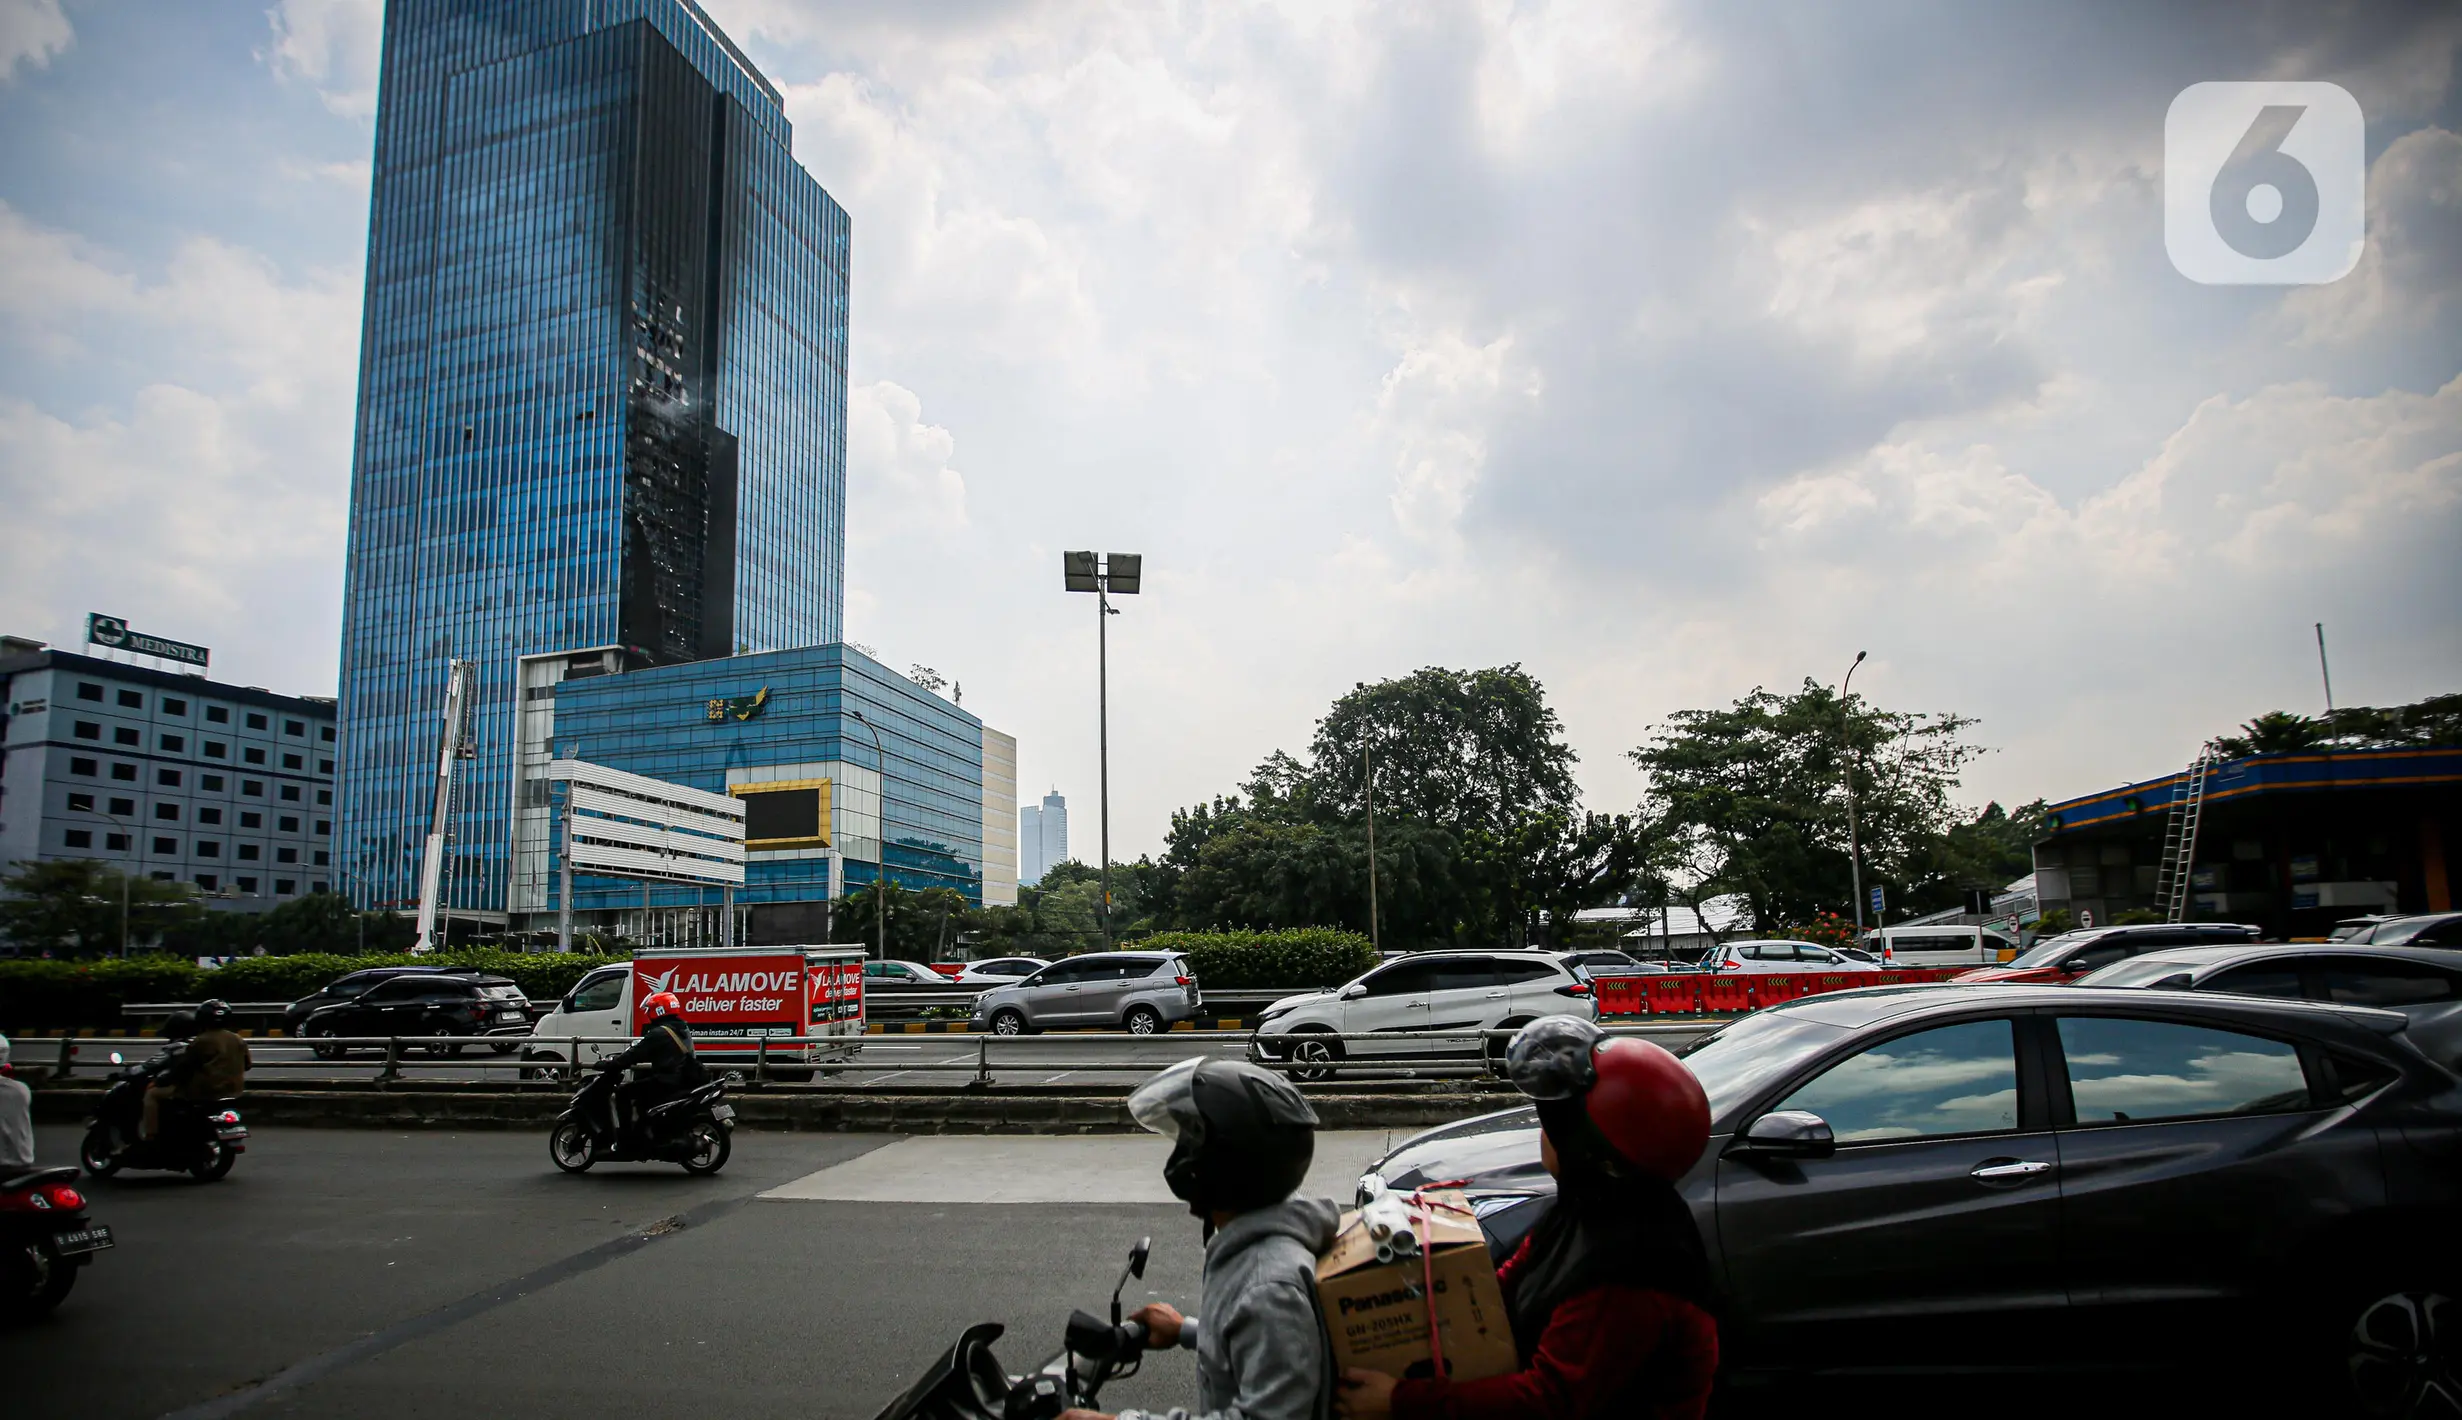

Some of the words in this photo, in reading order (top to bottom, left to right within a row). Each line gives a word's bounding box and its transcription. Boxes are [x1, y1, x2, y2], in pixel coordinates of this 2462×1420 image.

[131, 636, 206, 662] MEDISTRA
[672, 971, 799, 993] LALAMOVE
[822, 973, 860, 987] LAAOVE
[685, 996, 736, 1012] deliver
[739, 995, 783, 1012] faster
[709, 1028, 728, 1037] instan
[729, 1028, 744, 1037] 24/7
[1338, 1278, 1447, 1316] Panasoc
